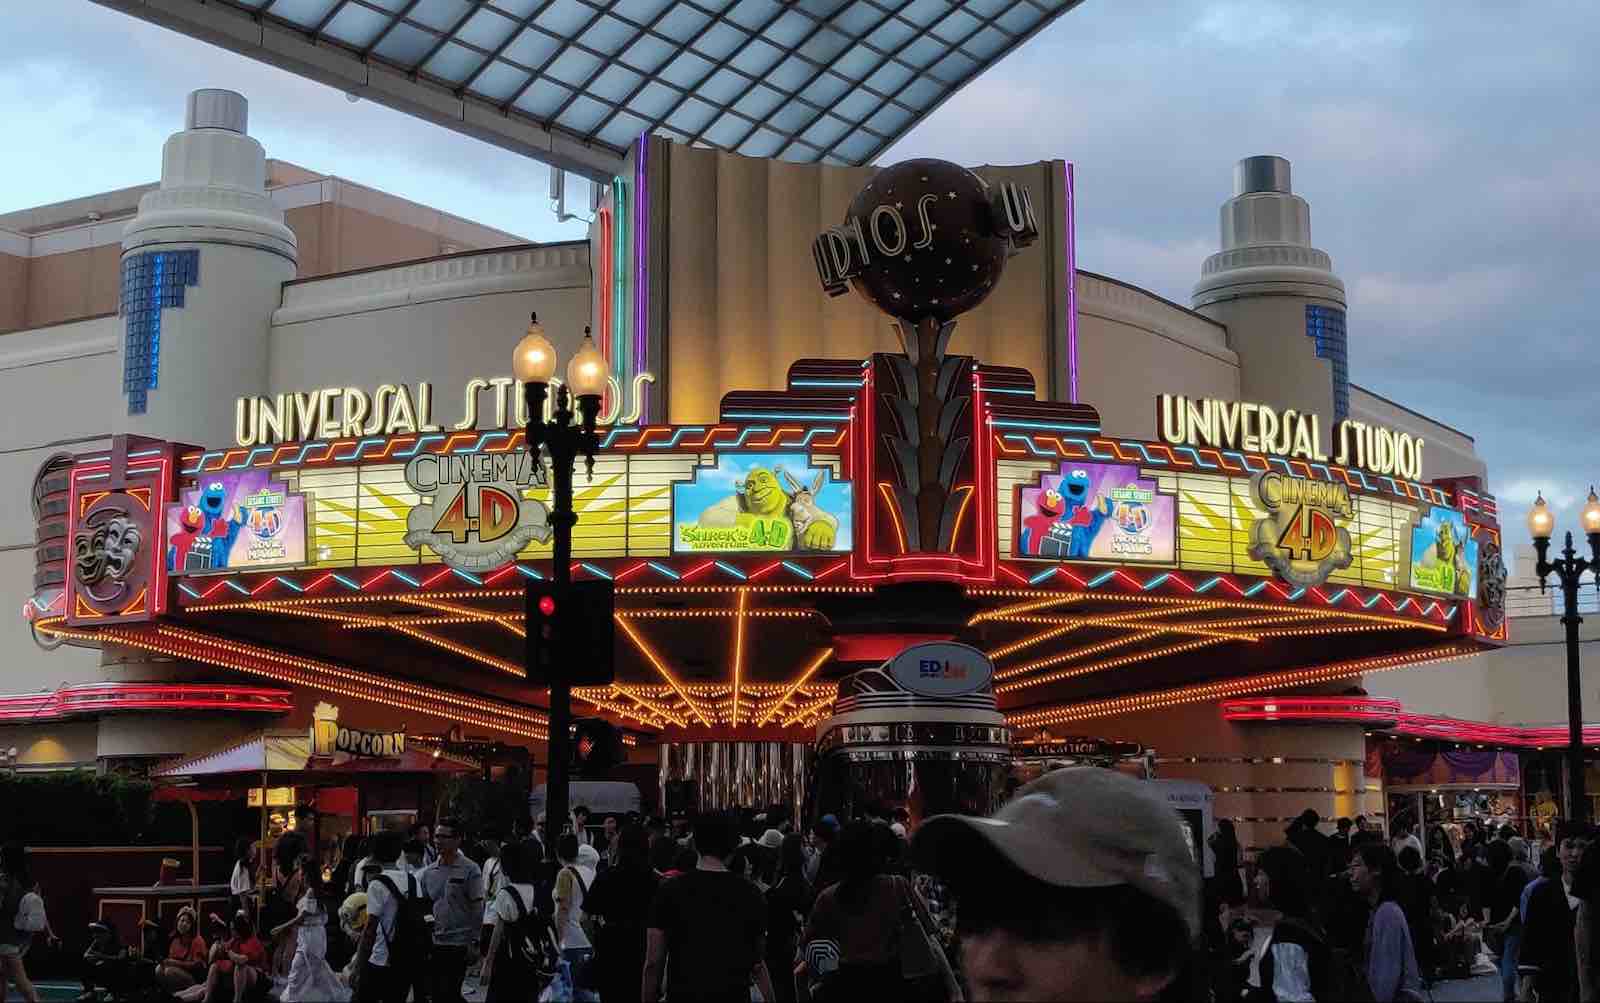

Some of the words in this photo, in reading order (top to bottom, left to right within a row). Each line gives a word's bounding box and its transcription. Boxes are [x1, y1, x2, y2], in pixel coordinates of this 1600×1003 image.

[236, 382, 440, 447] UNIVERSAL
[1162, 393, 1328, 462] UNIVERSAL
[1335, 420, 1425, 481] STUDIOS
[405, 452, 547, 492] CINEMA
[1258, 470, 1353, 518] CINEMA
[430, 481, 520, 544] 4-D
[1275, 502, 1337, 562] 4-D
[327, 721, 406, 756] POPCORN
